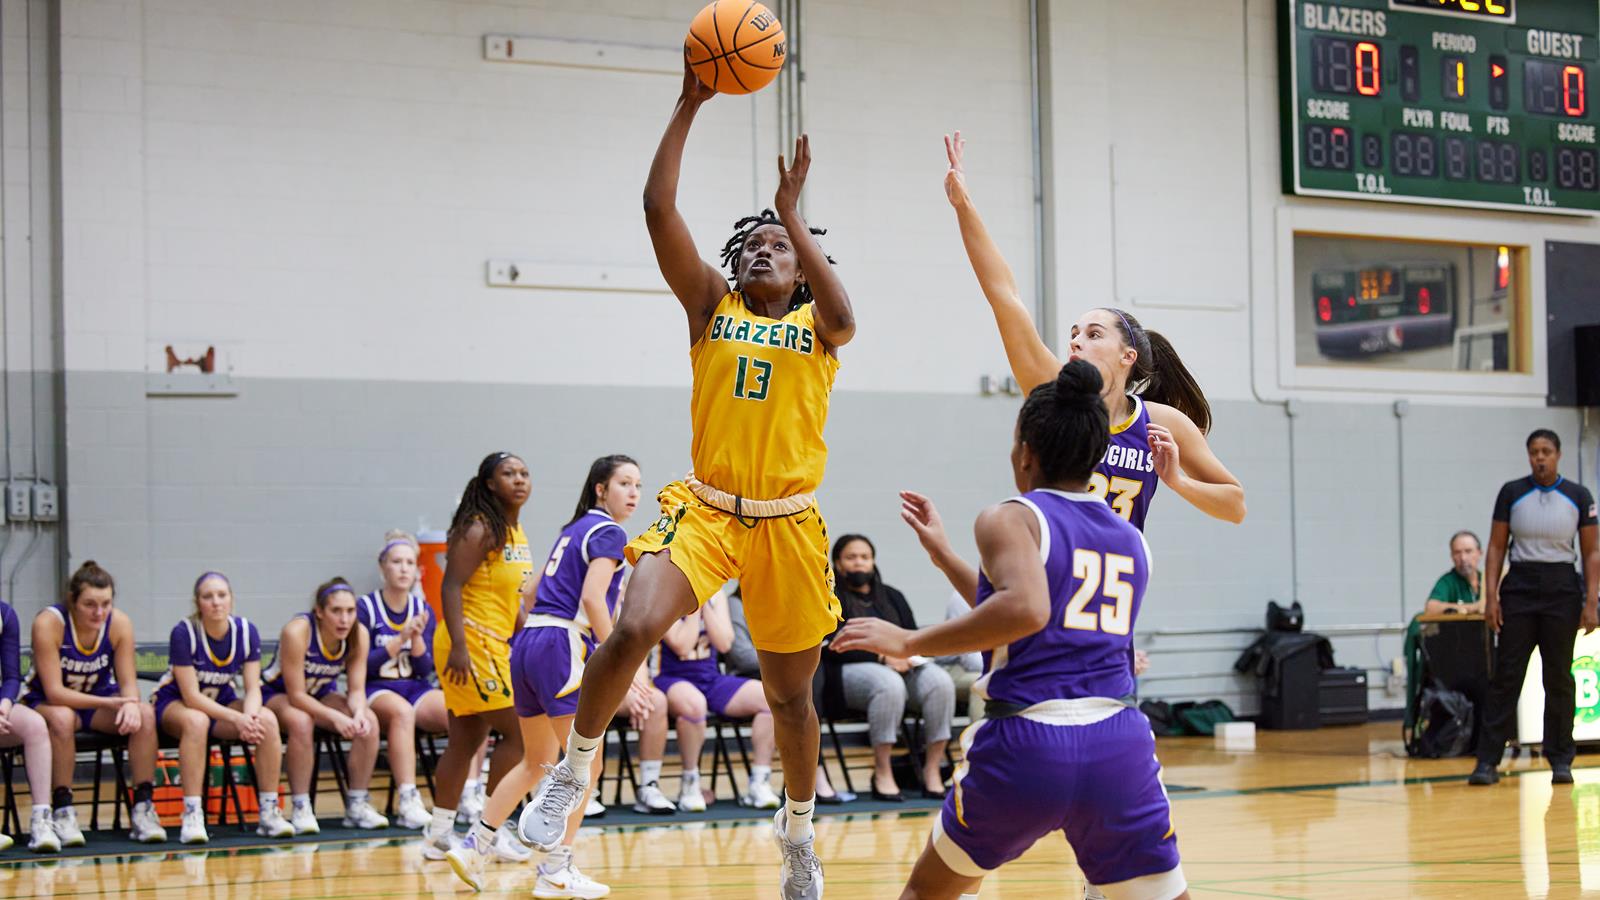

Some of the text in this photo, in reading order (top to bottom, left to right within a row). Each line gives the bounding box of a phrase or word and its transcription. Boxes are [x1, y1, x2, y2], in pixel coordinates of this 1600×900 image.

[1303, 4, 1386, 37] BLAZERS
[1432, 32, 1476, 53] PERIOD
[1526, 29, 1583, 59] GUEST
[1355, 41, 1381, 96] 0
[1456, 61, 1465, 97] 1
[1562, 65, 1585, 117] 0
[1306, 99, 1350, 121] SCORE
[1403, 108, 1510, 136] PLYR FOUL PTS
[1558, 123, 1595, 144] SCORE
[1355, 173, 1391, 194] T.O.L.
[1523, 187, 1555, 207] T.O.L.
[710, 315, 814, 354] BLAZERS
[733, 355, 773, 401] 13
[1100, 443, 1153, 473] GIRLS
[1063, 548, 1134, 636] 25
[1574, 669, 1599, 708] B
